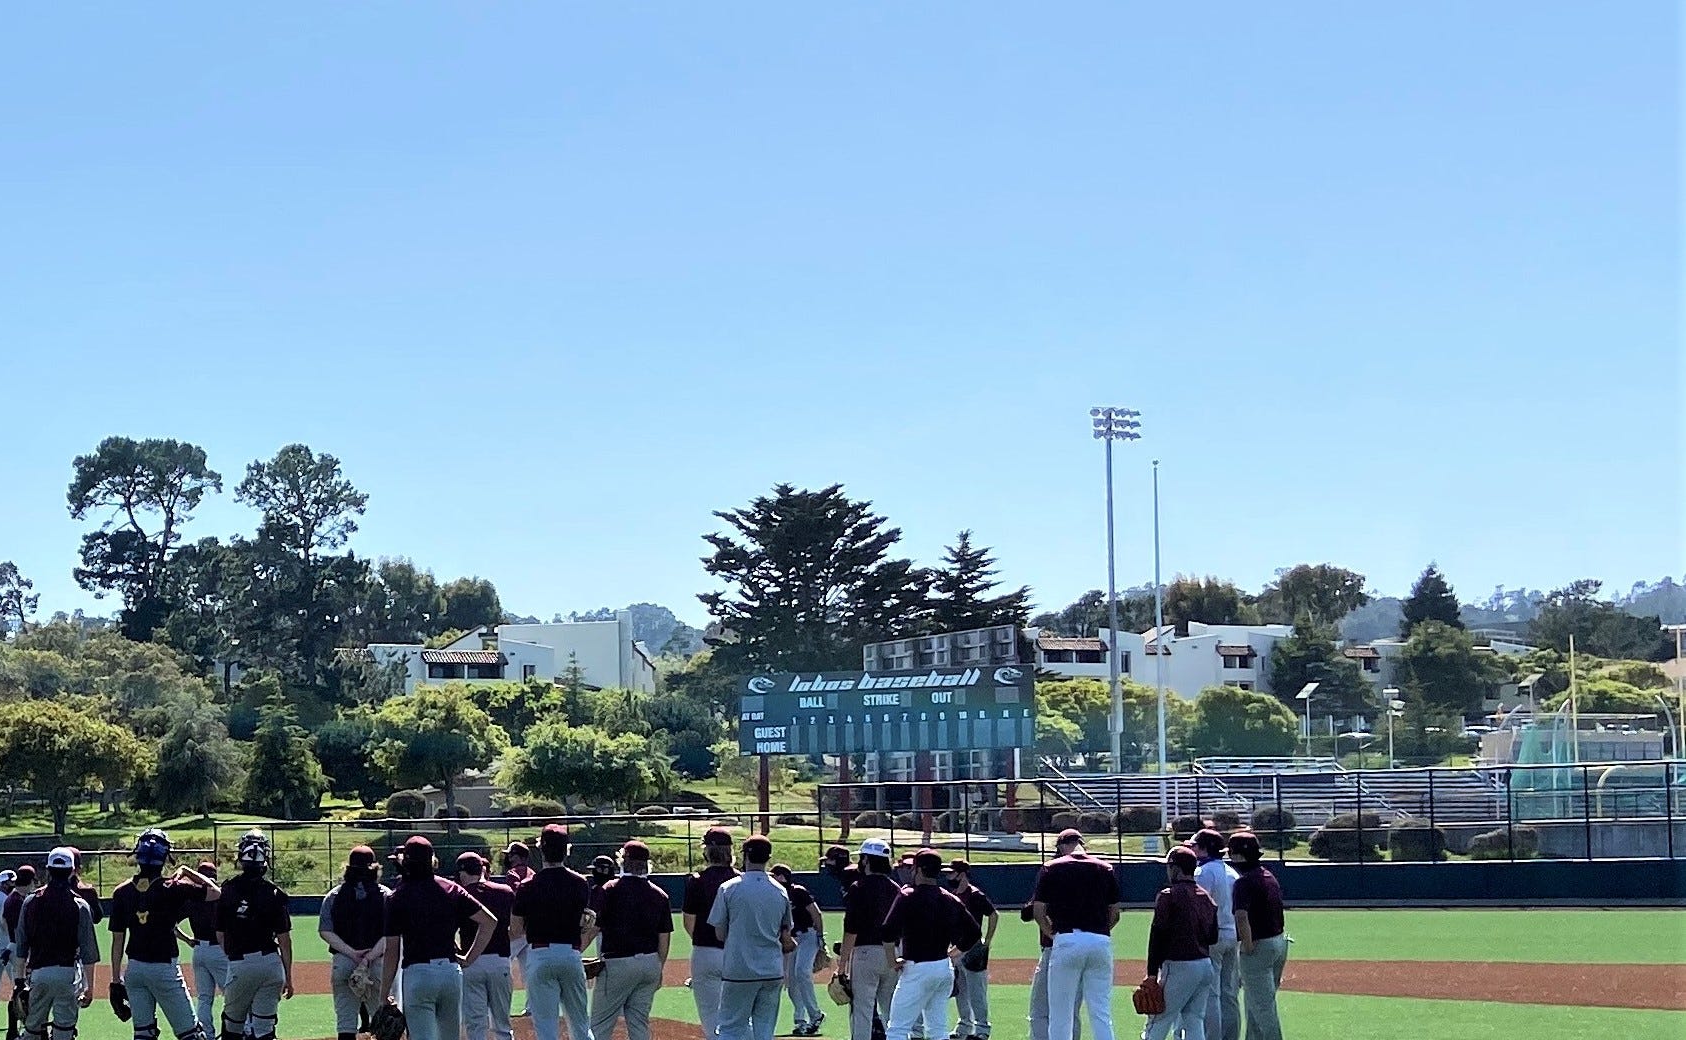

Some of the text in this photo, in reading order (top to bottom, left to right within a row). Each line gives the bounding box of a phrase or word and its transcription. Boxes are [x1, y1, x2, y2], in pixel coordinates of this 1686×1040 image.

[788, 667, 981, 692] lobos baseball
[799, 692, 953, 708] BALL STRIKE OUT
[754, 726, 786, 739] GUEST
[756, 741, 786, 753] HOME
